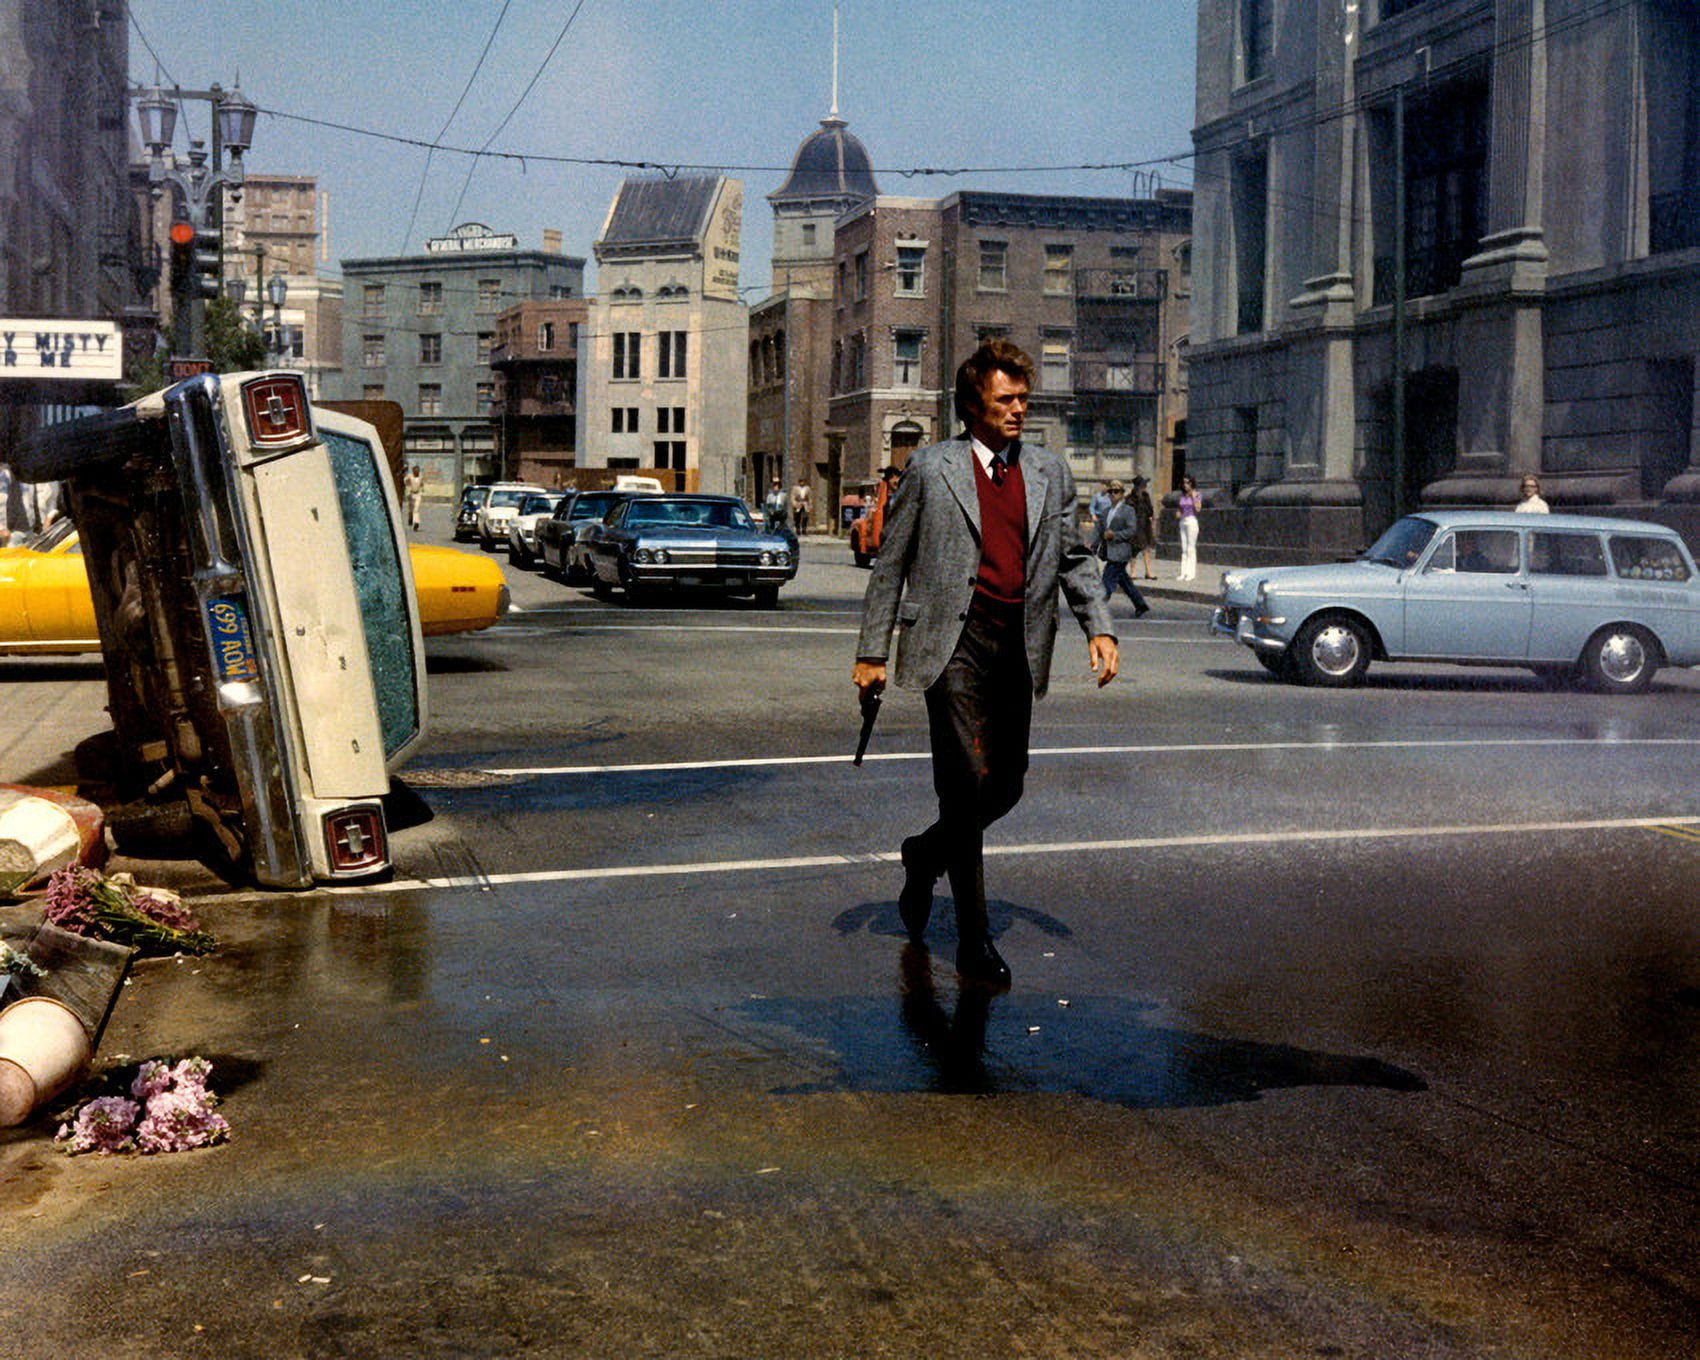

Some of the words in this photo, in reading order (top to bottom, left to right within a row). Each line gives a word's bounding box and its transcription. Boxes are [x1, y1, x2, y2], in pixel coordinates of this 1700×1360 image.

[3, 331, 16, 350] Y
[35, 332, 108, 352] MISTY
[4, 349, 17, 367] R
[40, 351, 71, 367] ME
[213, 603, 239, 635] 699
